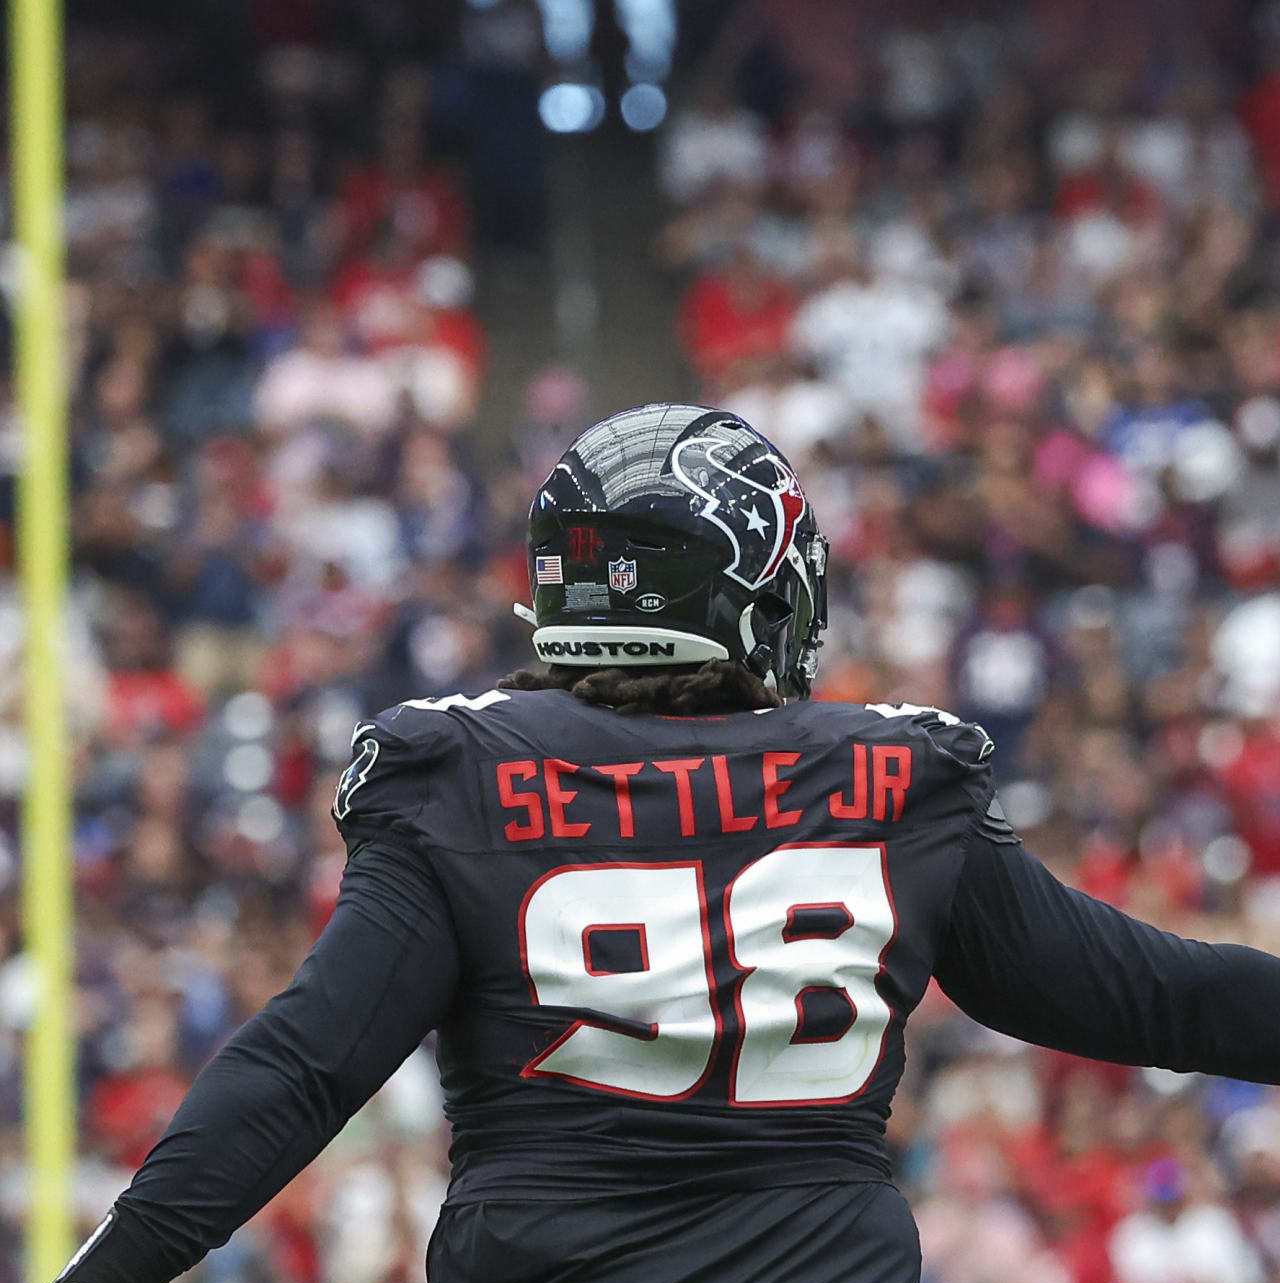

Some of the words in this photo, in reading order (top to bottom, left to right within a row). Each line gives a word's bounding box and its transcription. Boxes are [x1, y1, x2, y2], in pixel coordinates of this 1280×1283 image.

[612, 573, 634, 588] NFL
[537, 641, 675, 657] HOUSTON
[497, 751, 803, 842] SETTLE
[829, 743, 913, 822] JR
[518, 840, 899, 1107] 98
